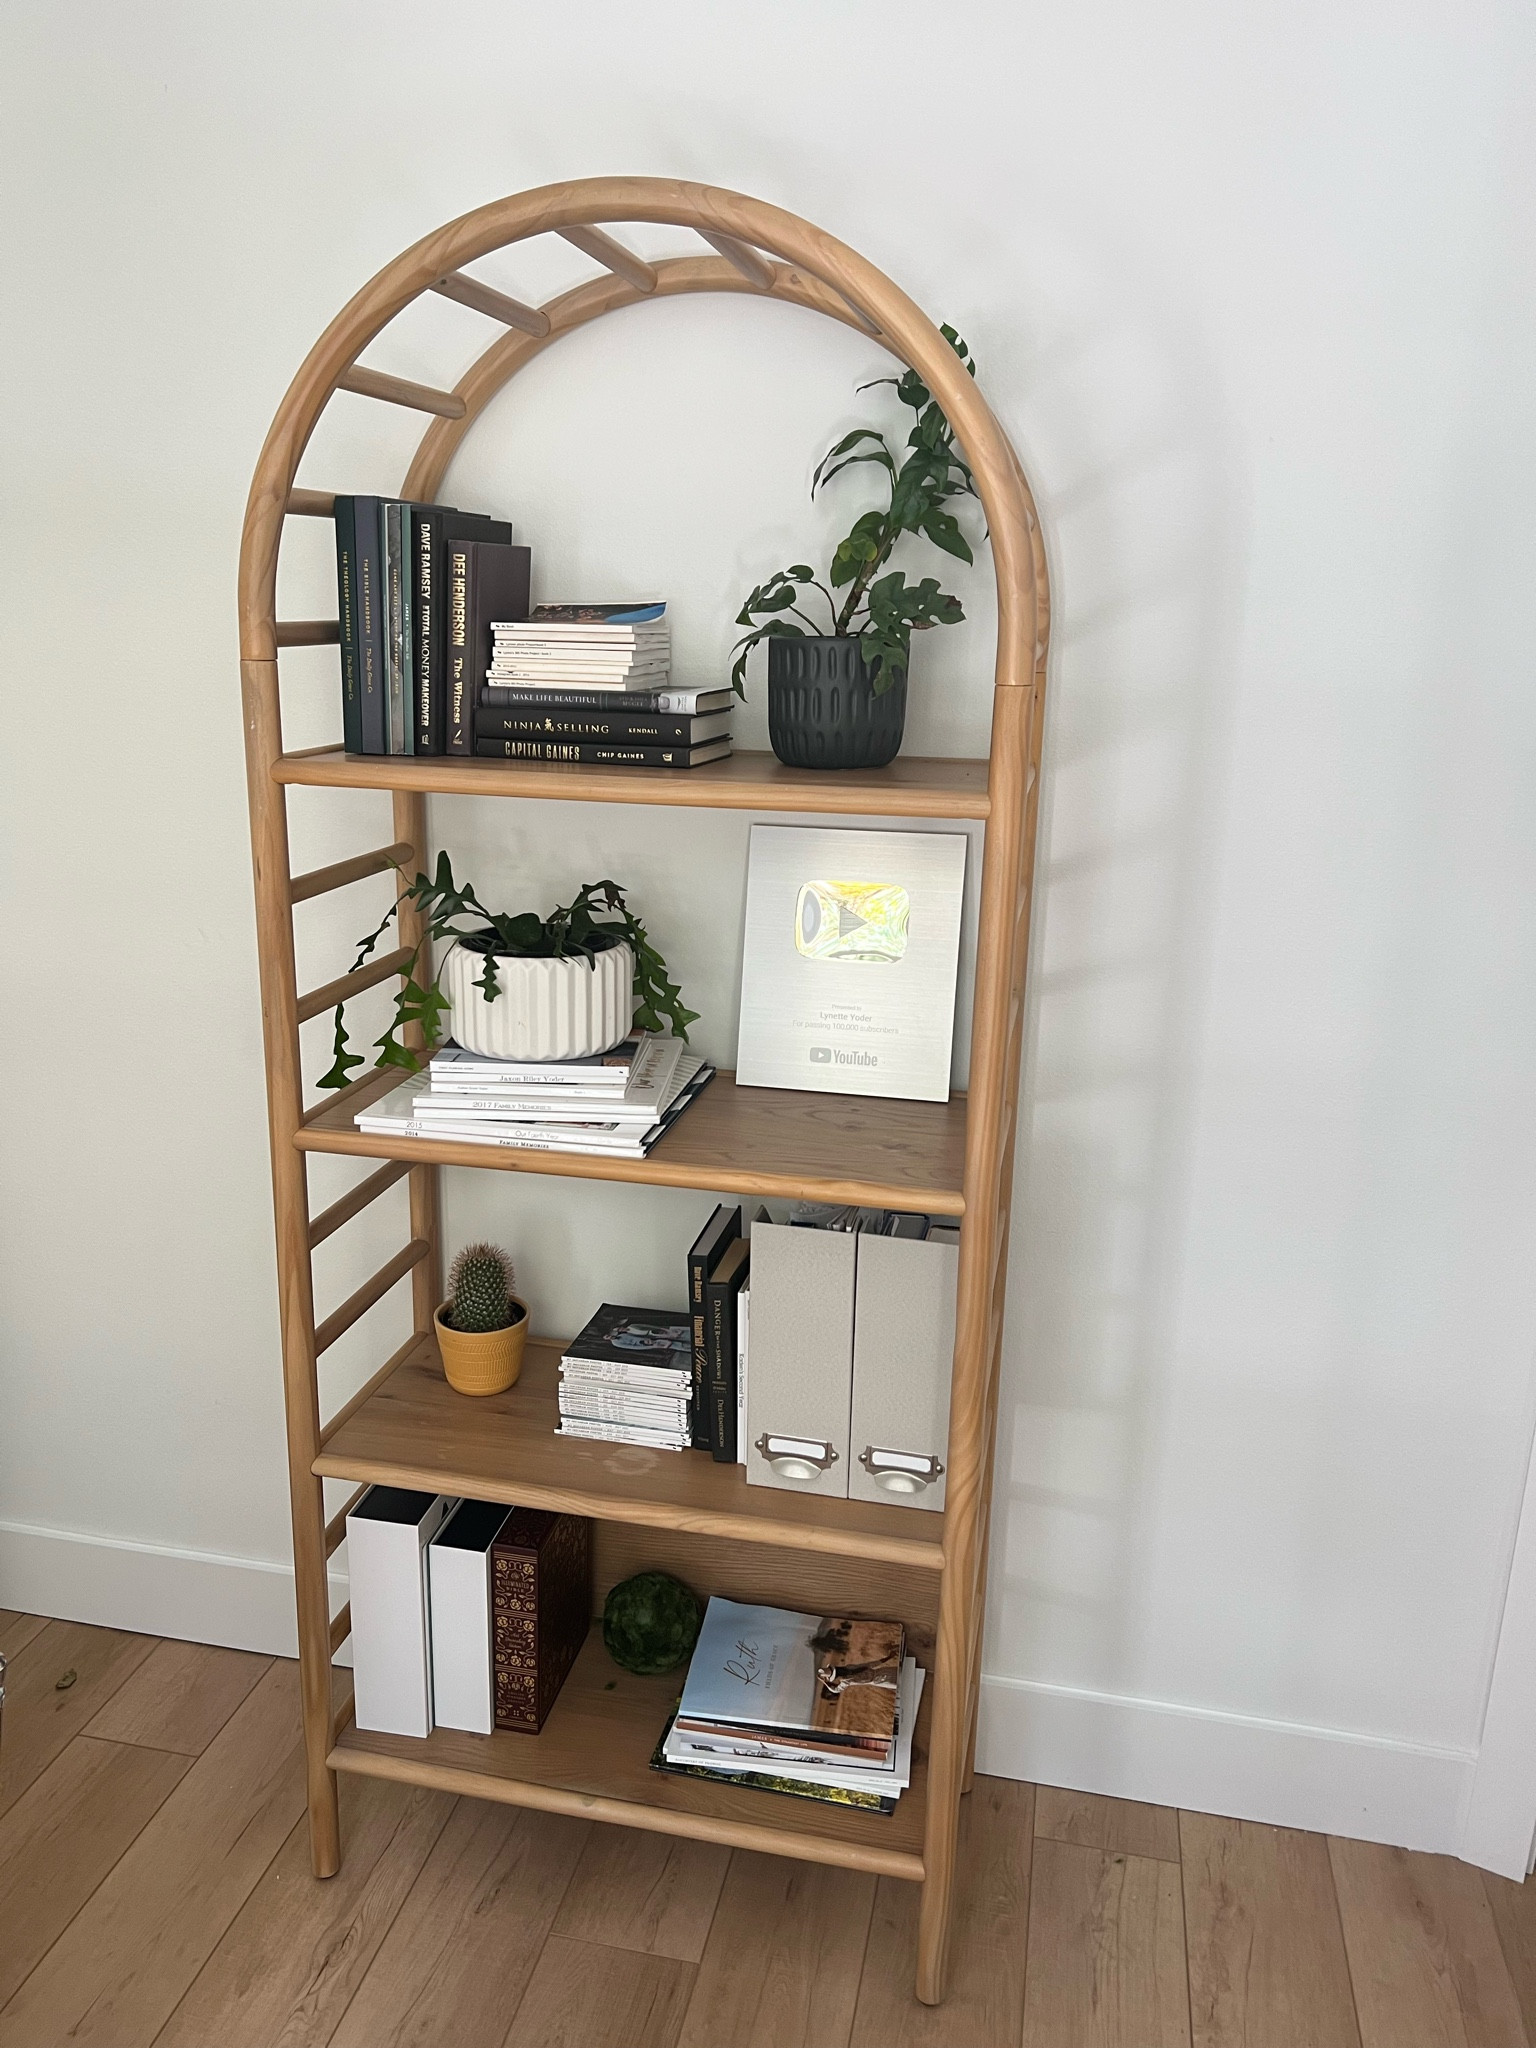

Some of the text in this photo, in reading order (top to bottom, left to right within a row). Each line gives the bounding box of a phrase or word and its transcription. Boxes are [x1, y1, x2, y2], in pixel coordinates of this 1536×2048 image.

[420, 523, 431, 599] DAVE RAMSEY
[452, 553, 466, 646] DEE HENDERSON
[344, 604, 352, 642] HANDBOOK
[422, 610, 430, 637] TOTAL
[421, 638, 430, 678] MONEY
[421, 678, 430, 727] MAKEOVER
[453, 657, 463, 724] The Witness
[512, 693, 597, 704] MAKE LIFE BEAUTIFUL
[503, 720, 542, 732] NINJA
[557, 722, 609, 734] SELLING
[628, 727, 659, 735] KENDALL
[504, 741, 580, 761] CAPITAL GAINES
[597, 751, 645, 761] CHIP GAINES
[792, 1019, 804, 1028] For
[804, 1021, 831, 1030] passing
[859, 1025, 899, 1034] subscribers
[820, 1012, 873, 1022] Lynette Yoder
[833, 1049, 878, 1067] YouTube
[406, 1121, 423, 1129] 2015
[693, 1316, 705, 1347] Financial
[713, 1299, 723, 1336] DANGER
[695, 1348, 708, 1384] Peace
[715, 1349, 723, 1380] SHADOWS
[717, 1399, 725, 1412] DEE
[718, 1412, 726, 1448] HENDERSON
[723, 1637, 762, 1686] Ruth
